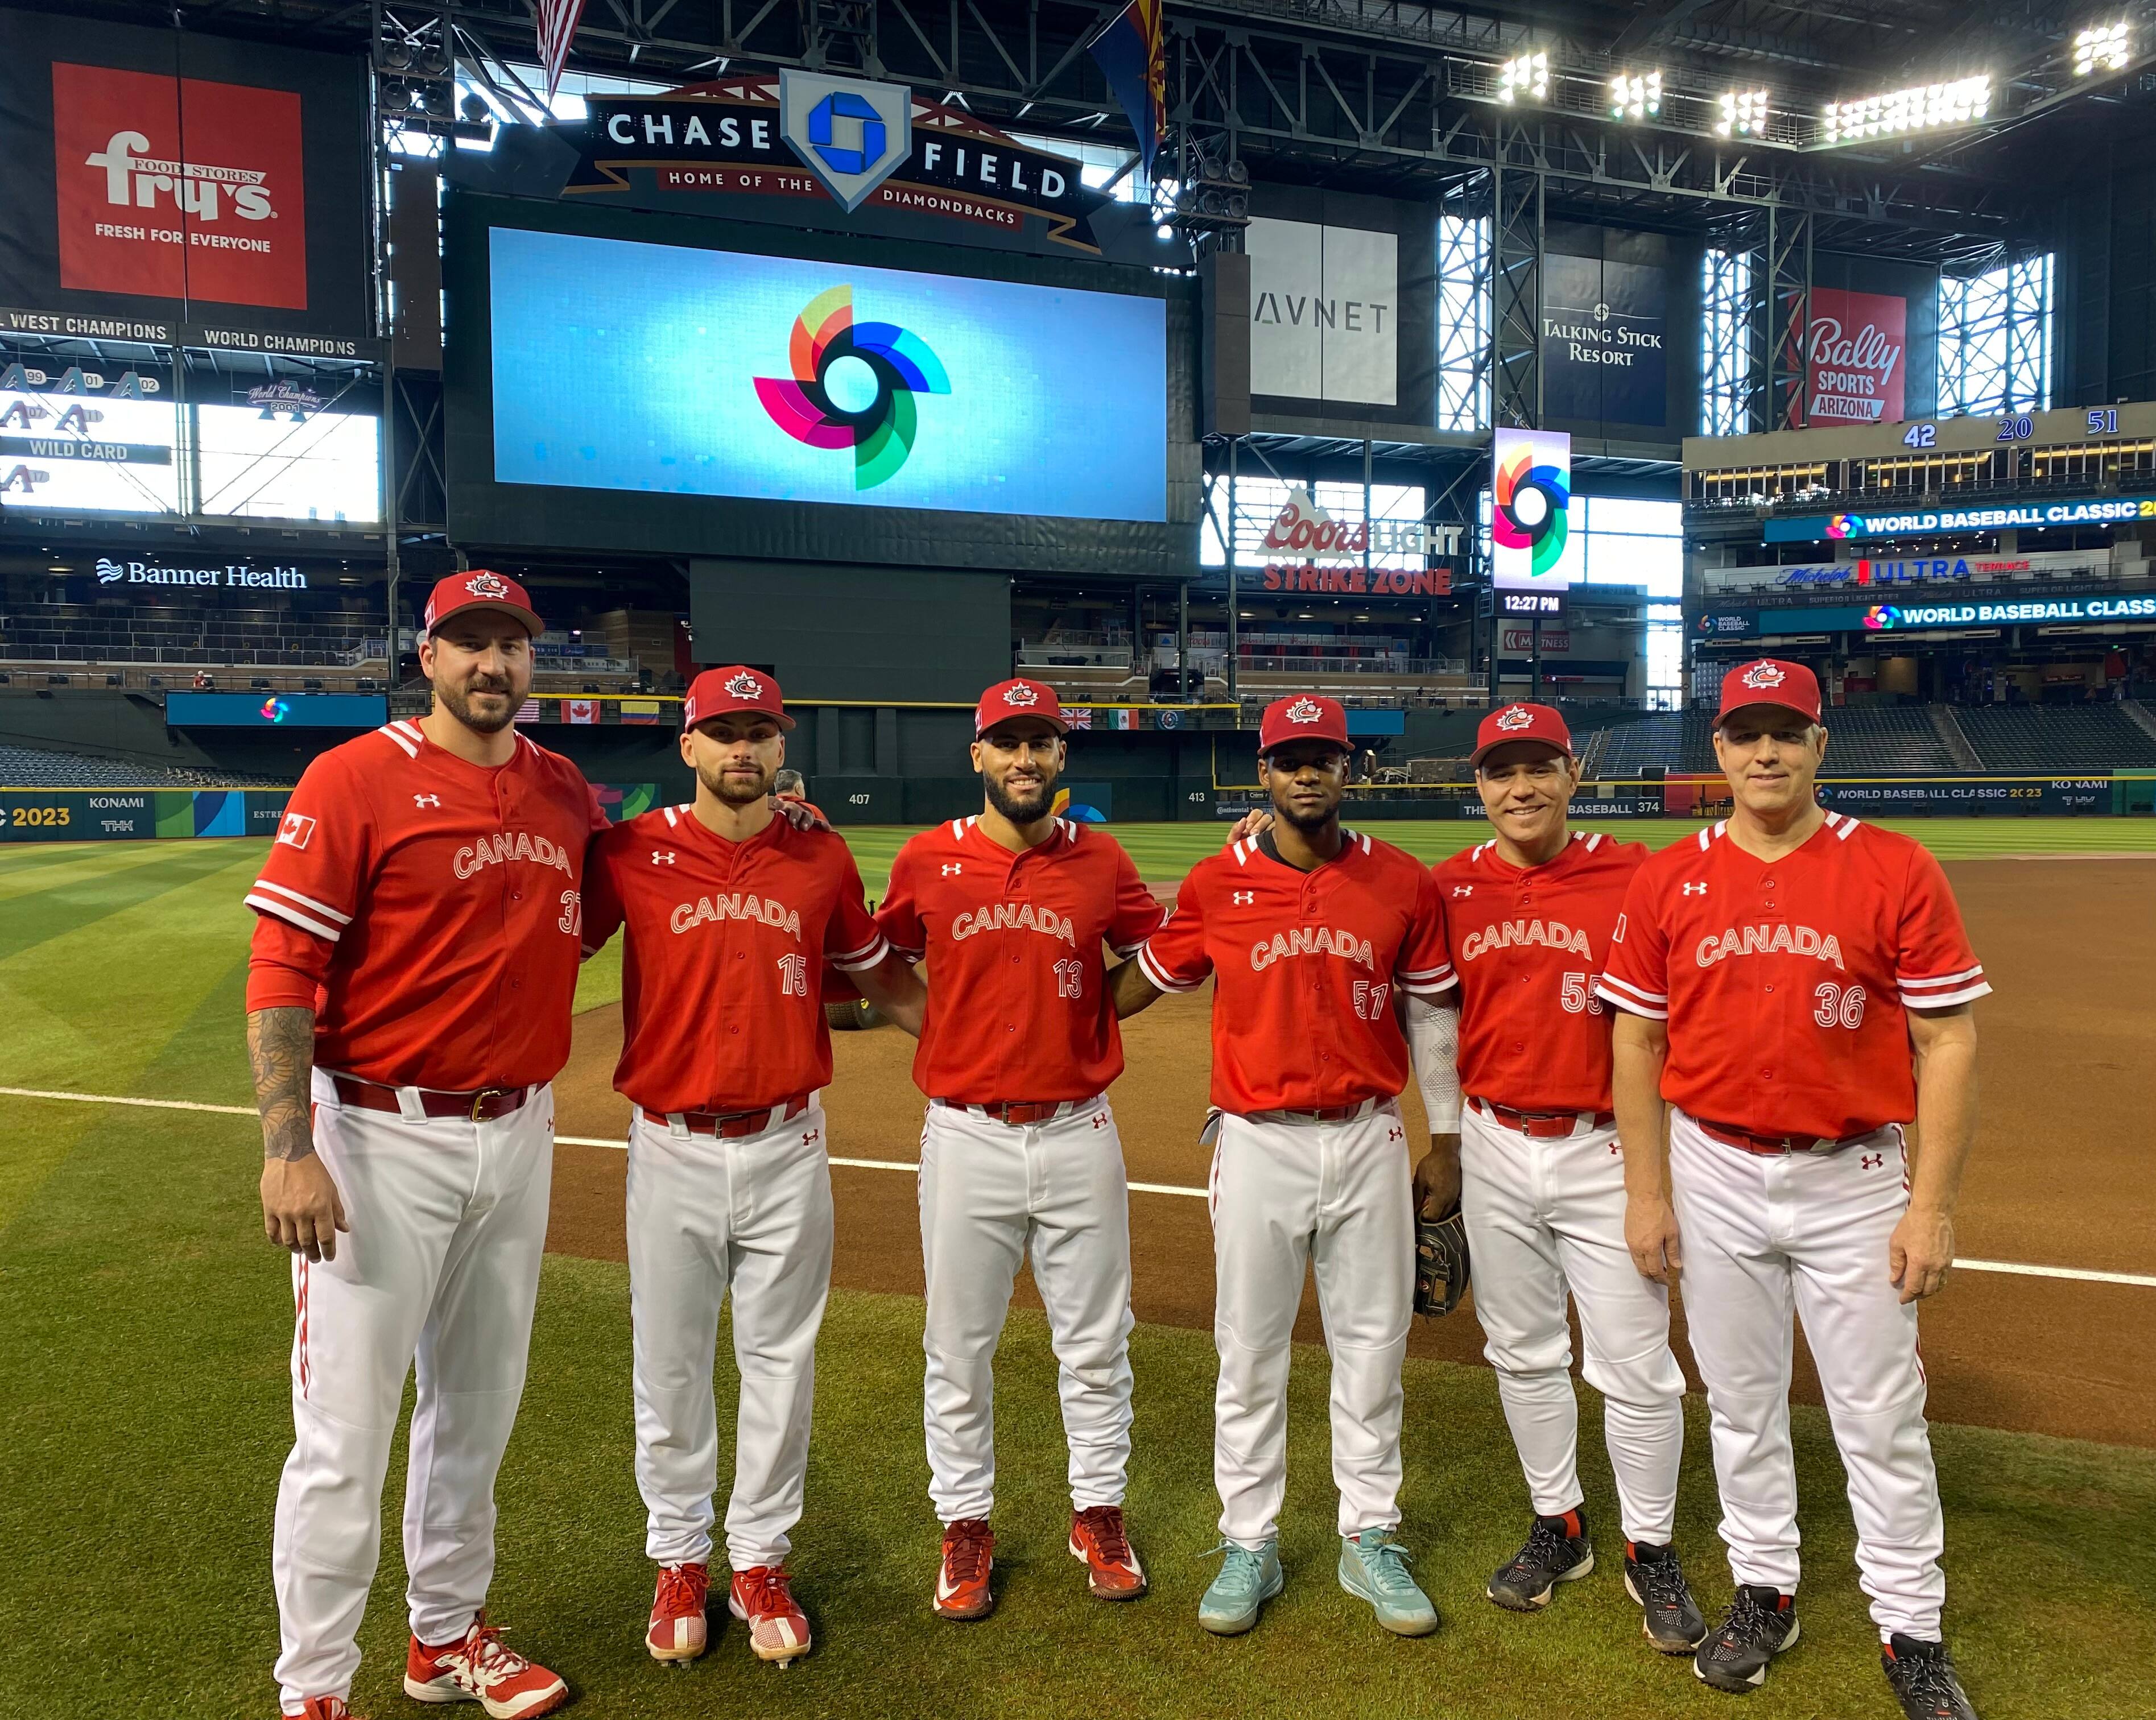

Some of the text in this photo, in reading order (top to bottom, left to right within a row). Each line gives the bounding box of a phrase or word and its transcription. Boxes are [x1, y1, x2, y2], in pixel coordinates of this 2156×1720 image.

[608, 113, 1067, 199] CHASE FIELD
[134, 159, 259, 183] FOOD STORES
[669, 172, 1015, 225] HOME OF THE DIAMONDBACKS
[94, 223, 271, 254] FRESH FOR EVERYONE
[1254, 292, 1387, 334] AVNET
[10, 313, 167, 340] WEST CHAMPIONS
[1543, 319, 1662, 349] TALKING STICK
[204, 330, 356, 355] WORLD CHAMPIONS
[1568, 342, 1634, 366] RESORT
[1801, 317, 1901, 385] Bally
[27, 371, 43, 382] 99
[85, 375, 98, 386] 01
[142, 379, 156, 390] 02
[249, 384, 321, 403] World Champions
[1818, 371, 1875, 395] SPORTS
[270, 402, 300, 412] 2001
[1819, 395, 1874, 419] ARIZONA
[1996, 416, 2034, 441] 20
[2087, 409, 2118, 435] 51
[1903, 424, 1936, 448] 42
[30, 440, 128, 460] WILD CARD
[1265, 503, 1464, 556] Coors LIGHT
[1865, 514, 1938, 534] WORLD
[1940, 508, 2045, 528] BASEBALL
[2047, 502, 2137, 521] CLASSIC
[127, 561, 308, 589] Banner Health
[1263, 563, 1452, 596] STRIKE ZONE
[1875, 559, 1970, 581] ULTRA
[1505, 596, 1560, 611] 12:27 PM
[1903, 599, 2156, 625] WORLD BASEBALL CLASS
[89, 797, 144, 808] KONAMI
[849, 794, 870, 805] 407
[1188, 792, 1205, 803] 413
[1638, 802, 1659, 812] 374
[1837, 789, 1881, 799] WORLD
[1884, 789, 1949, 799] BASEBALL
[1951, 789, 2007, 798] CLASSIC
[13, 807, 71, 826] 2023
[253, 811, 284, 819] ESTRE
[1464, 804, 1633, 815] THE BASEBALL
[101, 820, 134, 832] THK
[453, 833, 573, 879] CANADA
[670, 894, 800, 942] CANADA
[952, 903, 1076, 949] CANADA
[1250, 927, 1374, 971] CANADA
[1463, 920, 1593, 962] CANADA
[1696, 925, 1844, 971] CANADA
[777, 953, 807, 997] 15
[1052, 958, 1083, 999] 13
[1353, 981, 1389, 1020] 51
[1560, 972, 1603, 1015] 55
[1814, 982, 1866, 1029] 36
